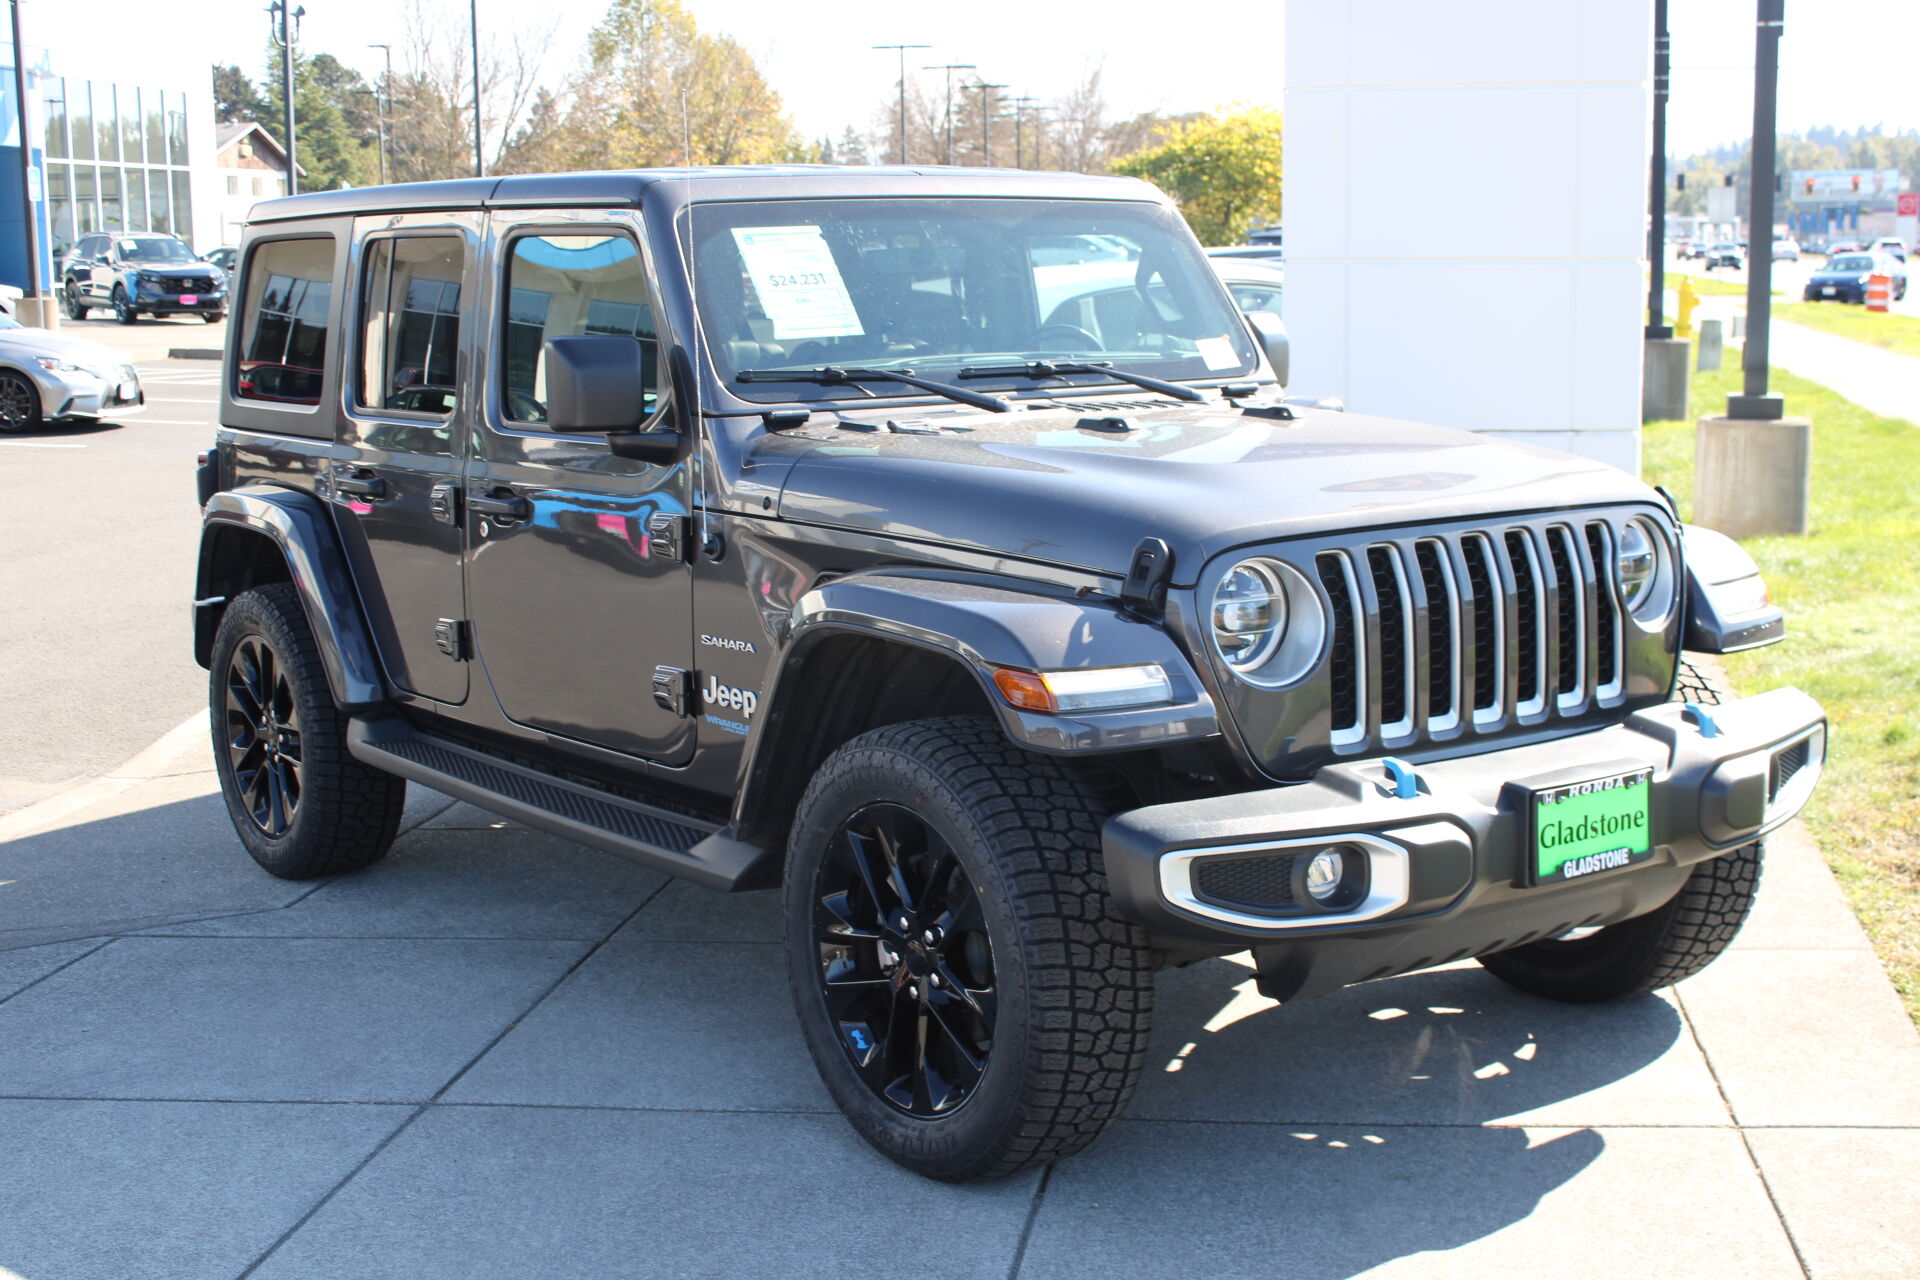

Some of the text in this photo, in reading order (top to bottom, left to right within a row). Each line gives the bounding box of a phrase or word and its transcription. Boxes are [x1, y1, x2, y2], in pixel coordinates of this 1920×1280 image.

[701, 634, 756, 653] SAHARA
[702, 675, 757, 719] Jeep
[1568, 778, 1624, 797] HONDA
[1540, 810, 1644, 848] Gladstone
[1563, 847, 1629, 878] GLADSTONE
